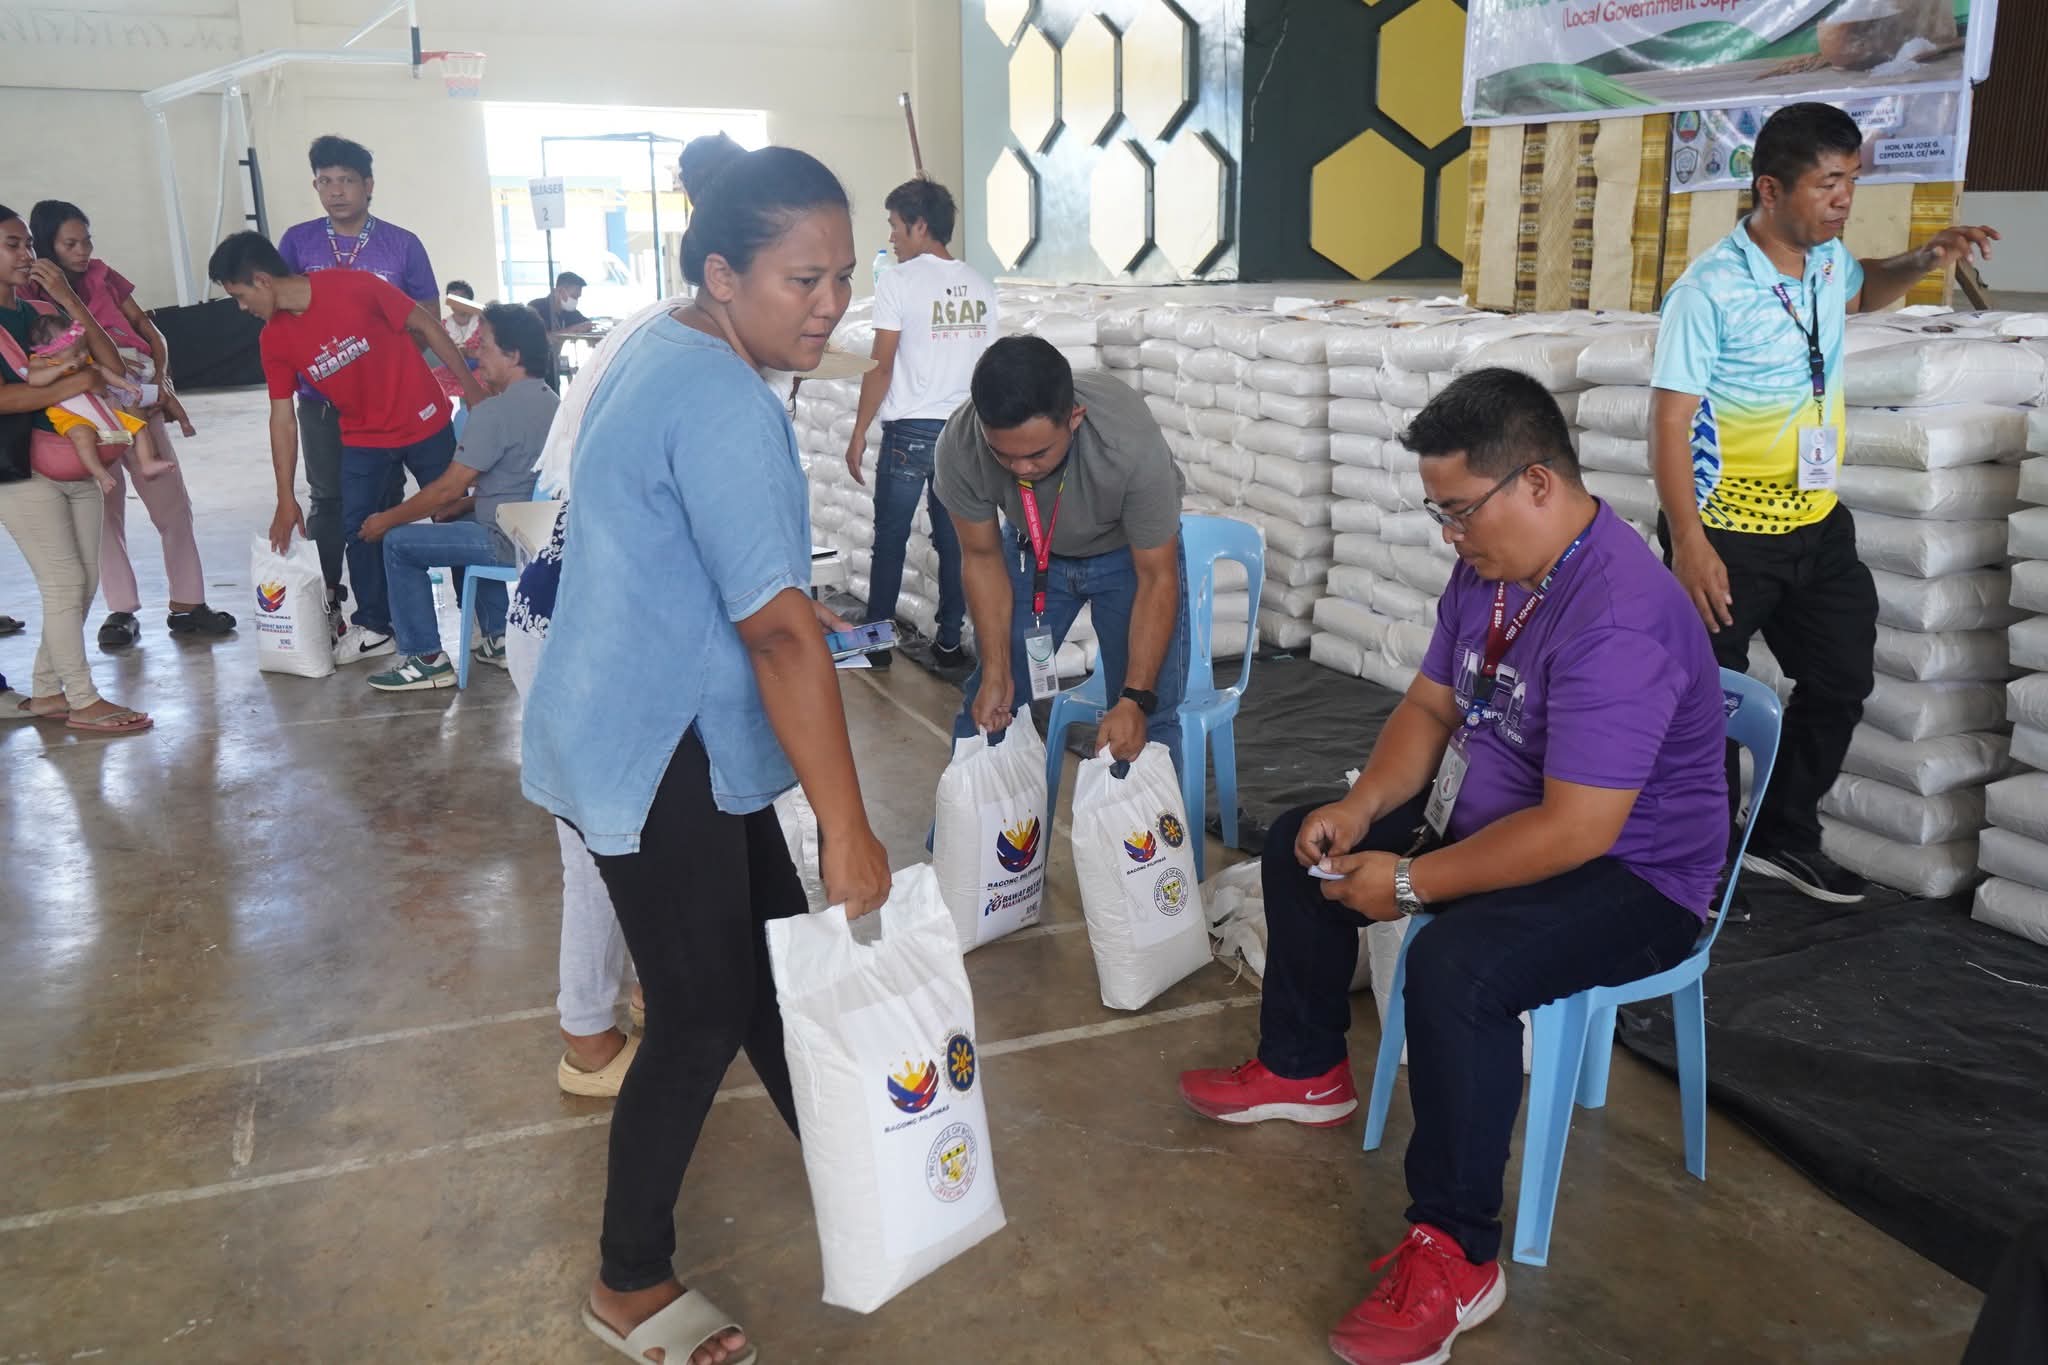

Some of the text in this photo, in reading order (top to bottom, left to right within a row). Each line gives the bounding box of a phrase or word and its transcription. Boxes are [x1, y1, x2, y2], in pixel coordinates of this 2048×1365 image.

[1562, 2, 1600, 32] (Local
[1602, 0, 1696, 22] Government
[542, 207, 550, 222] 2
[931, 299, 987, 325] AGAP
[306, 337, 370, 383] REBORN
[929, 1128, 951, 1178] PROVINCE
